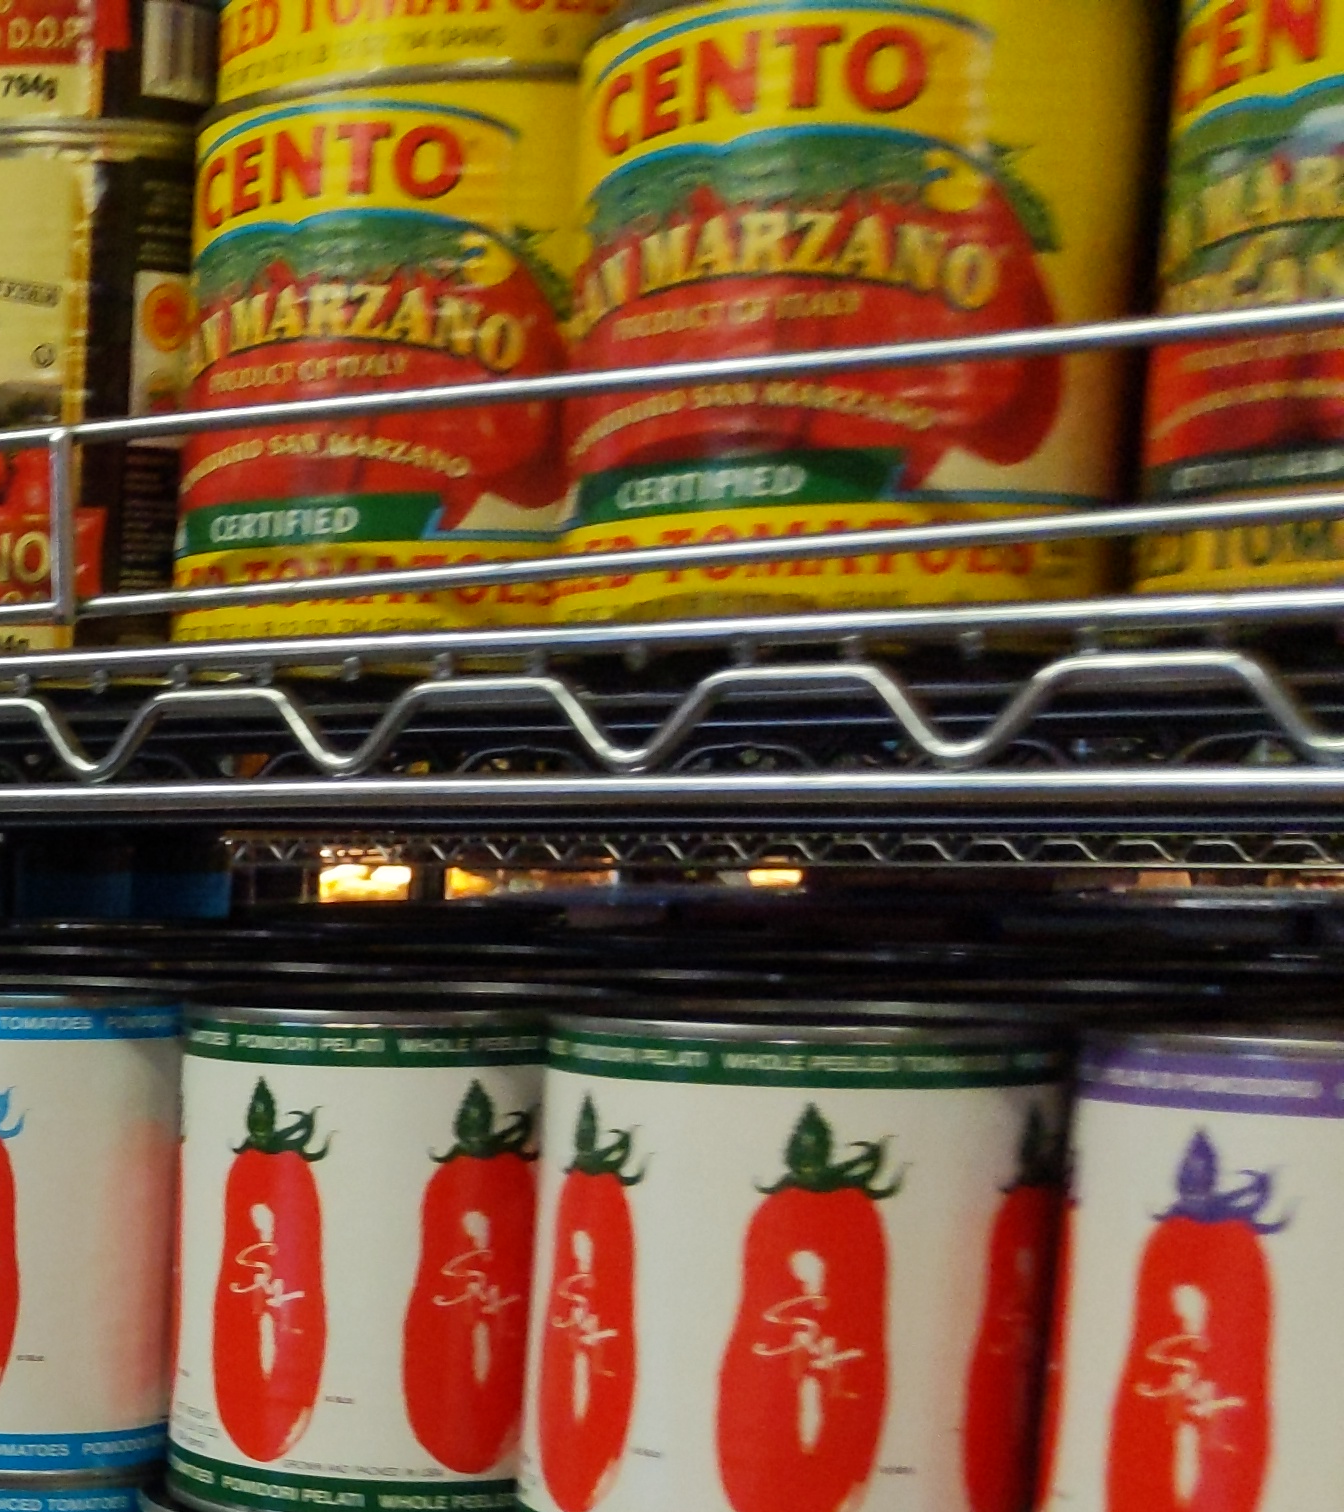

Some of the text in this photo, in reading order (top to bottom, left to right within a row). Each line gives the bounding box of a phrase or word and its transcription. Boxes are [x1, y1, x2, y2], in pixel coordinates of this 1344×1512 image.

[597, 25, 928, 157] CENTO
[202, 123, 463, 230] CENTO
[642, 210, 996, 311] MARZANO
[231, 283, 523, 372] MARZANO
[212, 506, 360, 539] CERTIFIED
[616, 465, 808, 510] CERTIFIED
